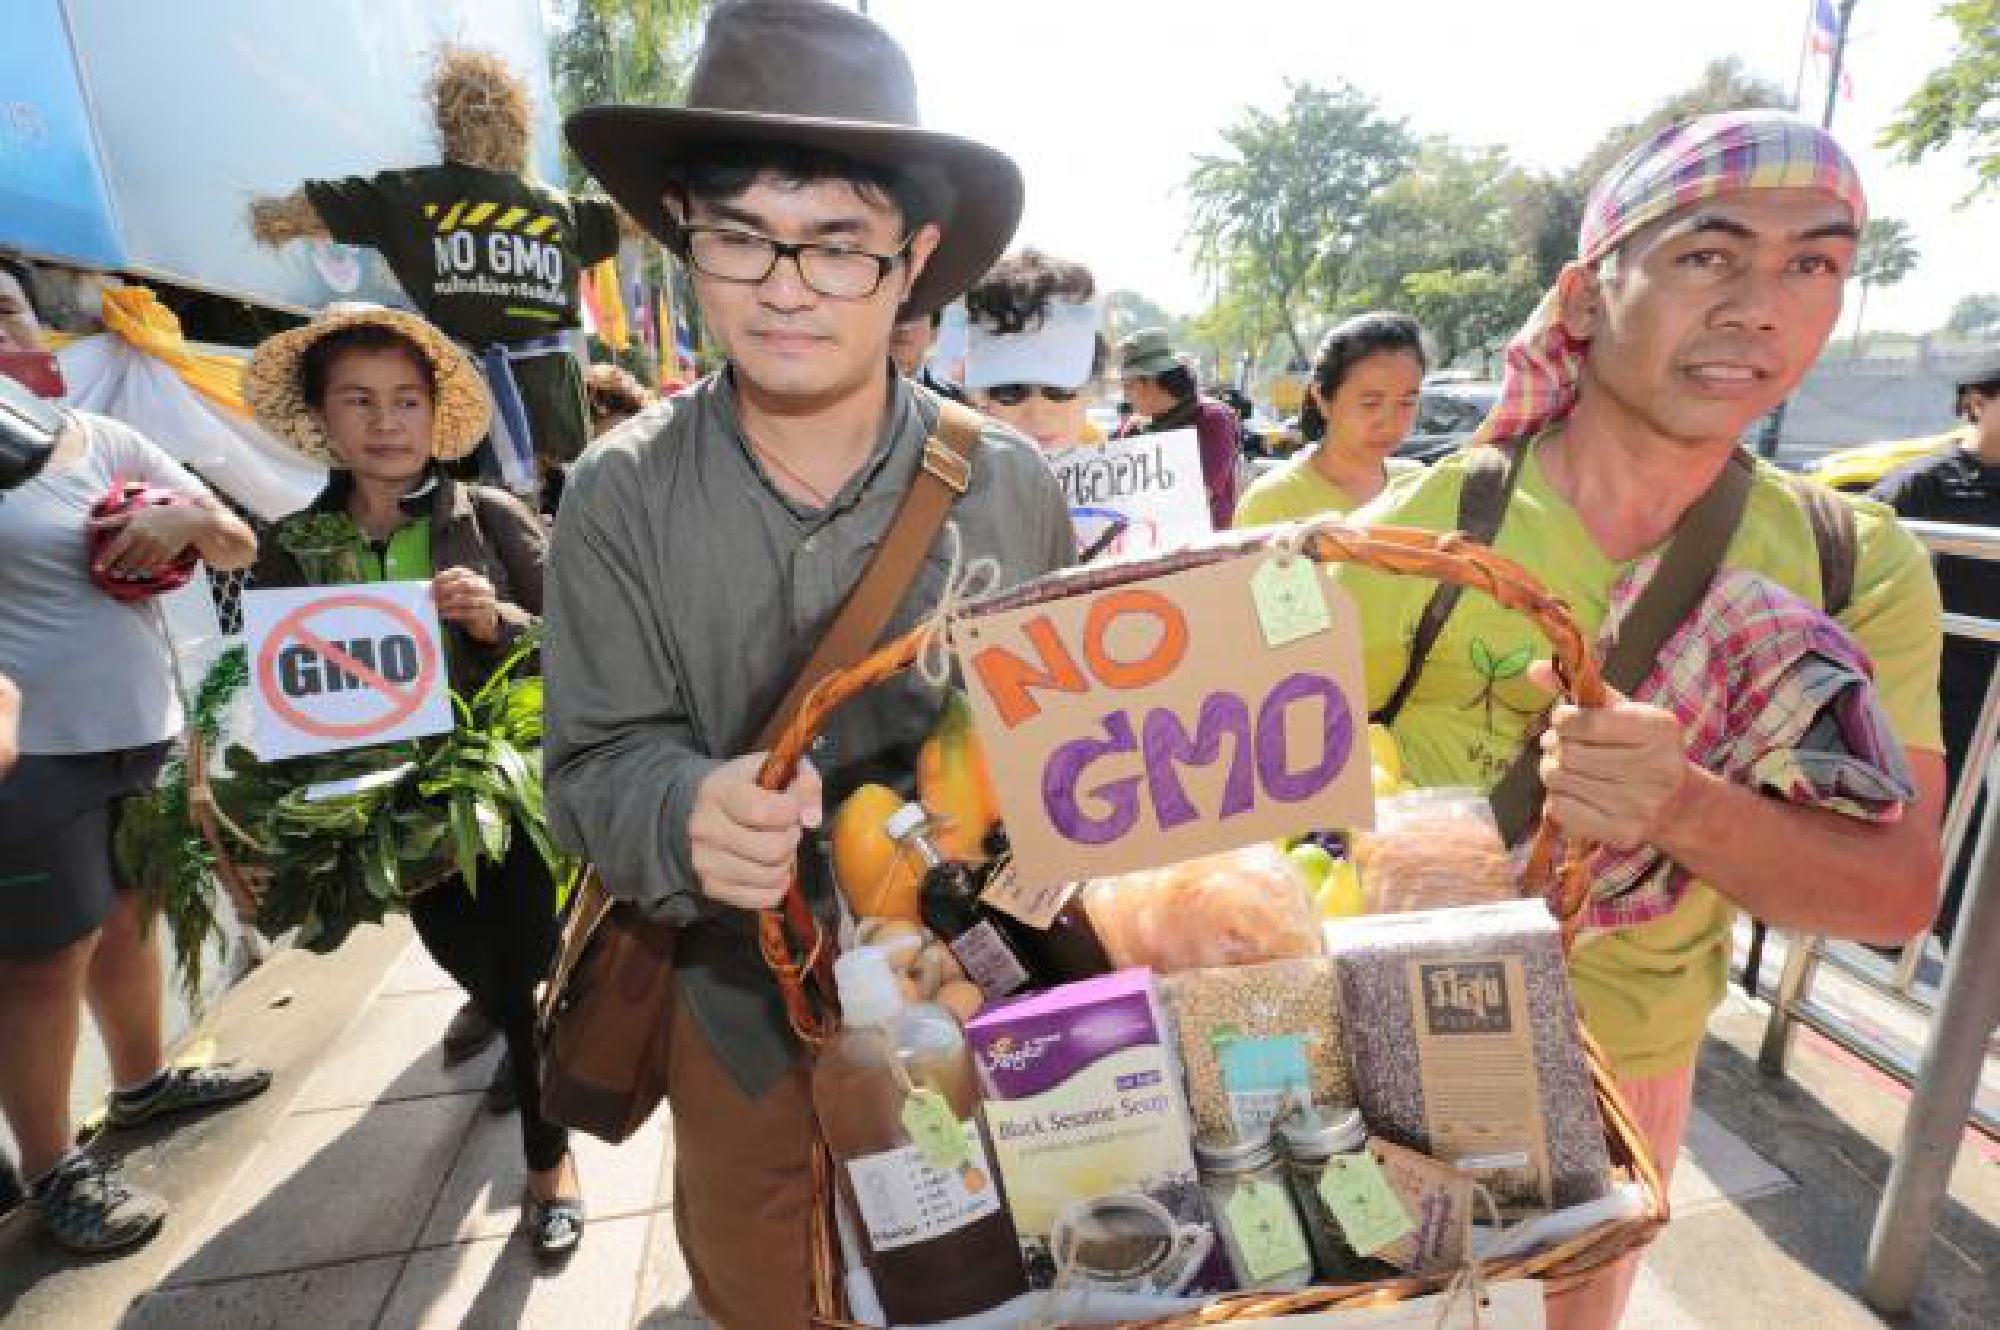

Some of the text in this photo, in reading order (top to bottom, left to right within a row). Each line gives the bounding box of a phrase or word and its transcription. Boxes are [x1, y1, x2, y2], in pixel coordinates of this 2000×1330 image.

[434, 230, 563, 284] NO GMO
[278, 633, 419, 698] GMO
[970, 589, 1189, 730] NO
[1040, 671, 1354, 845] GMO
[998, 1114, 1045, 1140] Black
